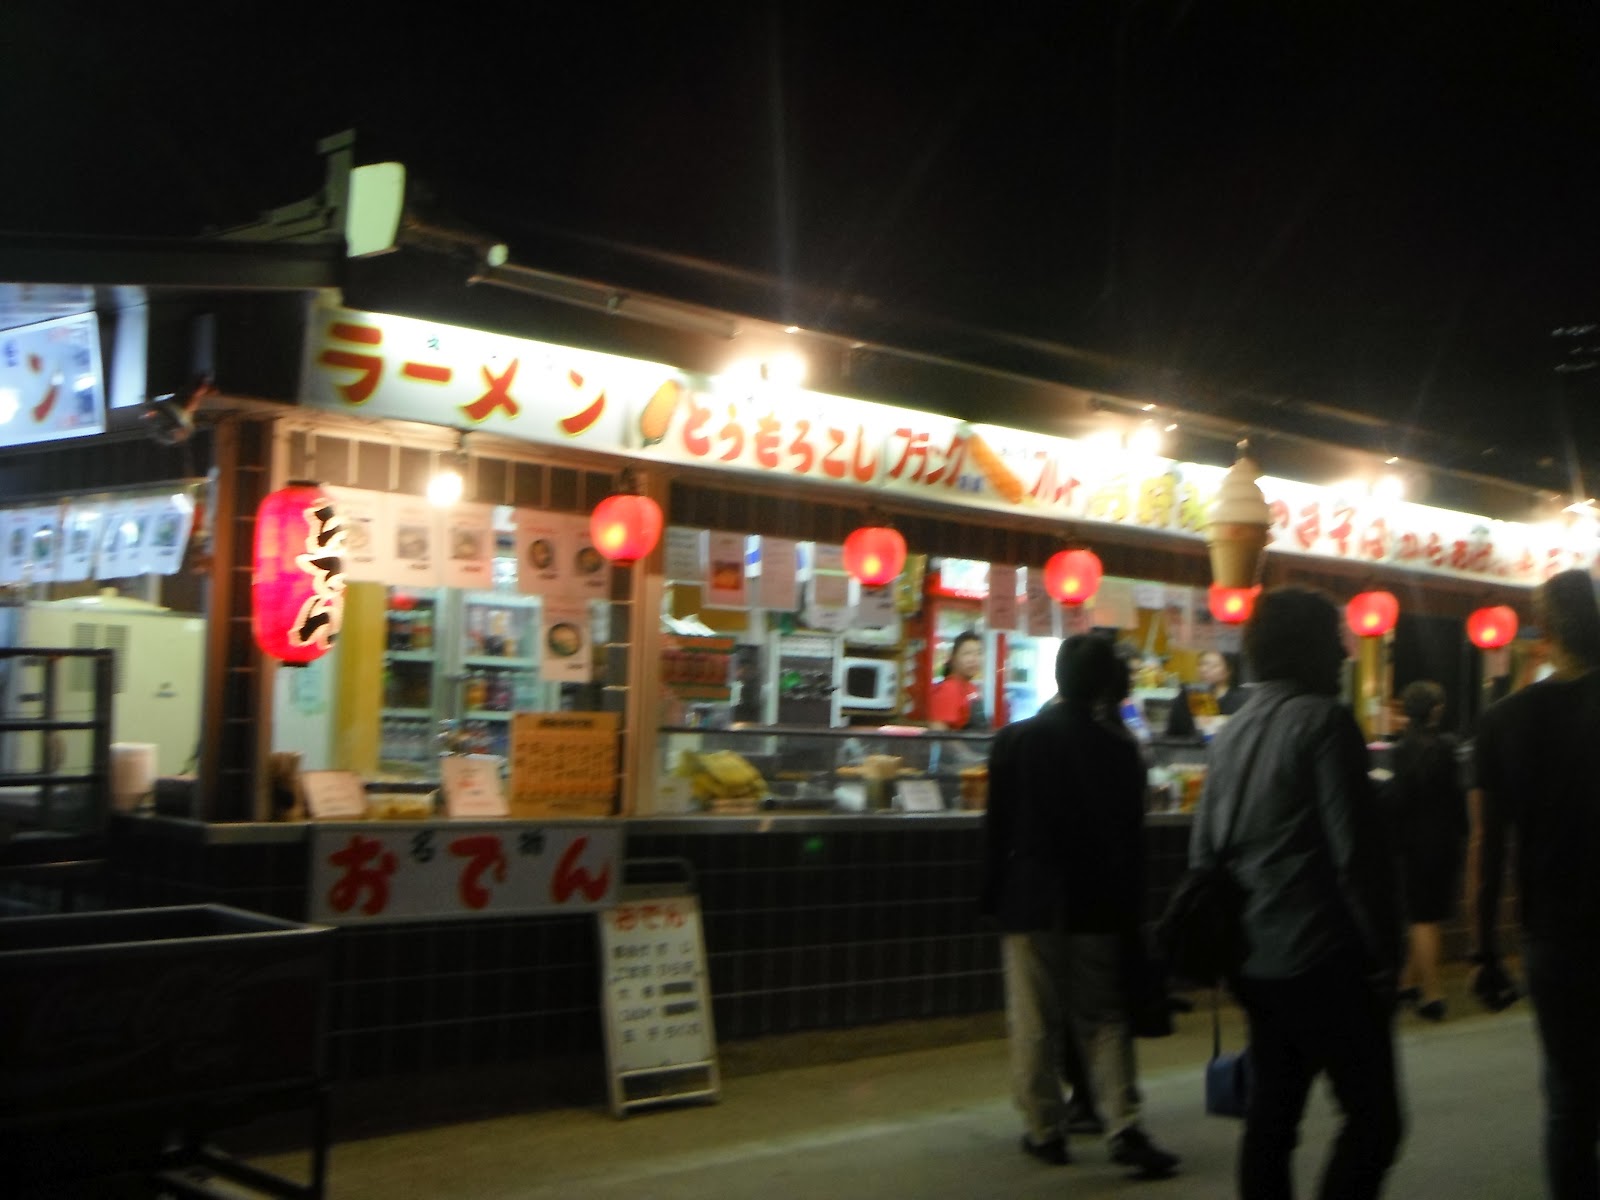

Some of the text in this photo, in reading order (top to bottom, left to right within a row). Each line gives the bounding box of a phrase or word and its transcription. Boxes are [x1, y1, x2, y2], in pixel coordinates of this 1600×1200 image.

[318, 321, 606, 436] ラーメン
[682, 396, 876, 484] とうもろこし
[327, 834, 610, 916] おでん
